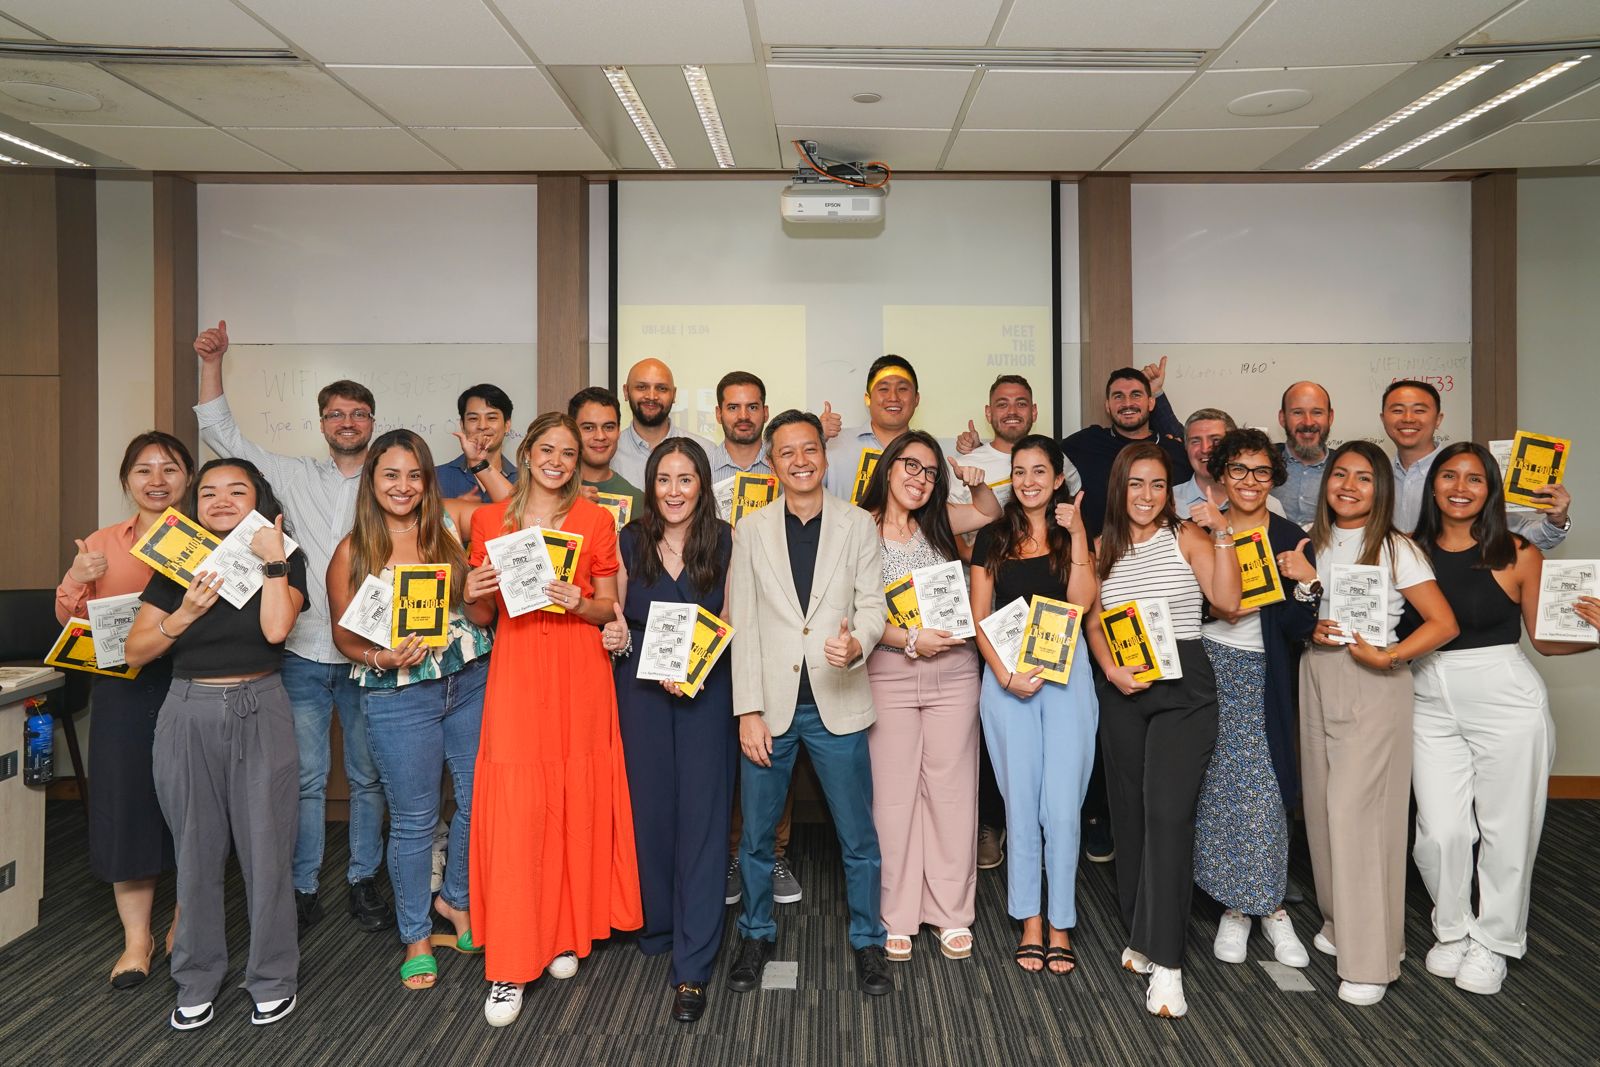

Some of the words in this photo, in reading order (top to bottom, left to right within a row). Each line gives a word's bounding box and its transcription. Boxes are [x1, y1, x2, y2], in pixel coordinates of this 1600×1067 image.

[1002, 324, 1036, 337] MEET
[1012, 339, 1036, 352] THE
[986, 354, 1036, 367] AUTHOR
[525, 542, 536, 550] The
[512, 555, 528, 565] PRICE
[232, 560, 249, 575] Being
[535, 563, 543, 571] Of
[521, 576, 538, 587] Being
[1560, 582, 1577, 590] PRICE
[235, 581, 249, 594] FAIR
[933, 587, 947, 595] PRICE
[1349, 586, 1366, 596] PRICE
[370, 590, 381, 601] The
[399, 599, 418, 609] LAST
[420, 598, 445, 609] FOOLS
[371, 606, 386, 621] PRICE
[940, 608, 954, 617] Being
[1013, 611, 1023, 621] The
[114, 616, 132, 625] PRICE
[678, 614, 687, 622] The
[661, 623, 676, 632] PRICE
[1006, 626, 1021, 638] PRICE
[659, 647, 673, 655] Being
[670, 660, 682, 668] FAIR
